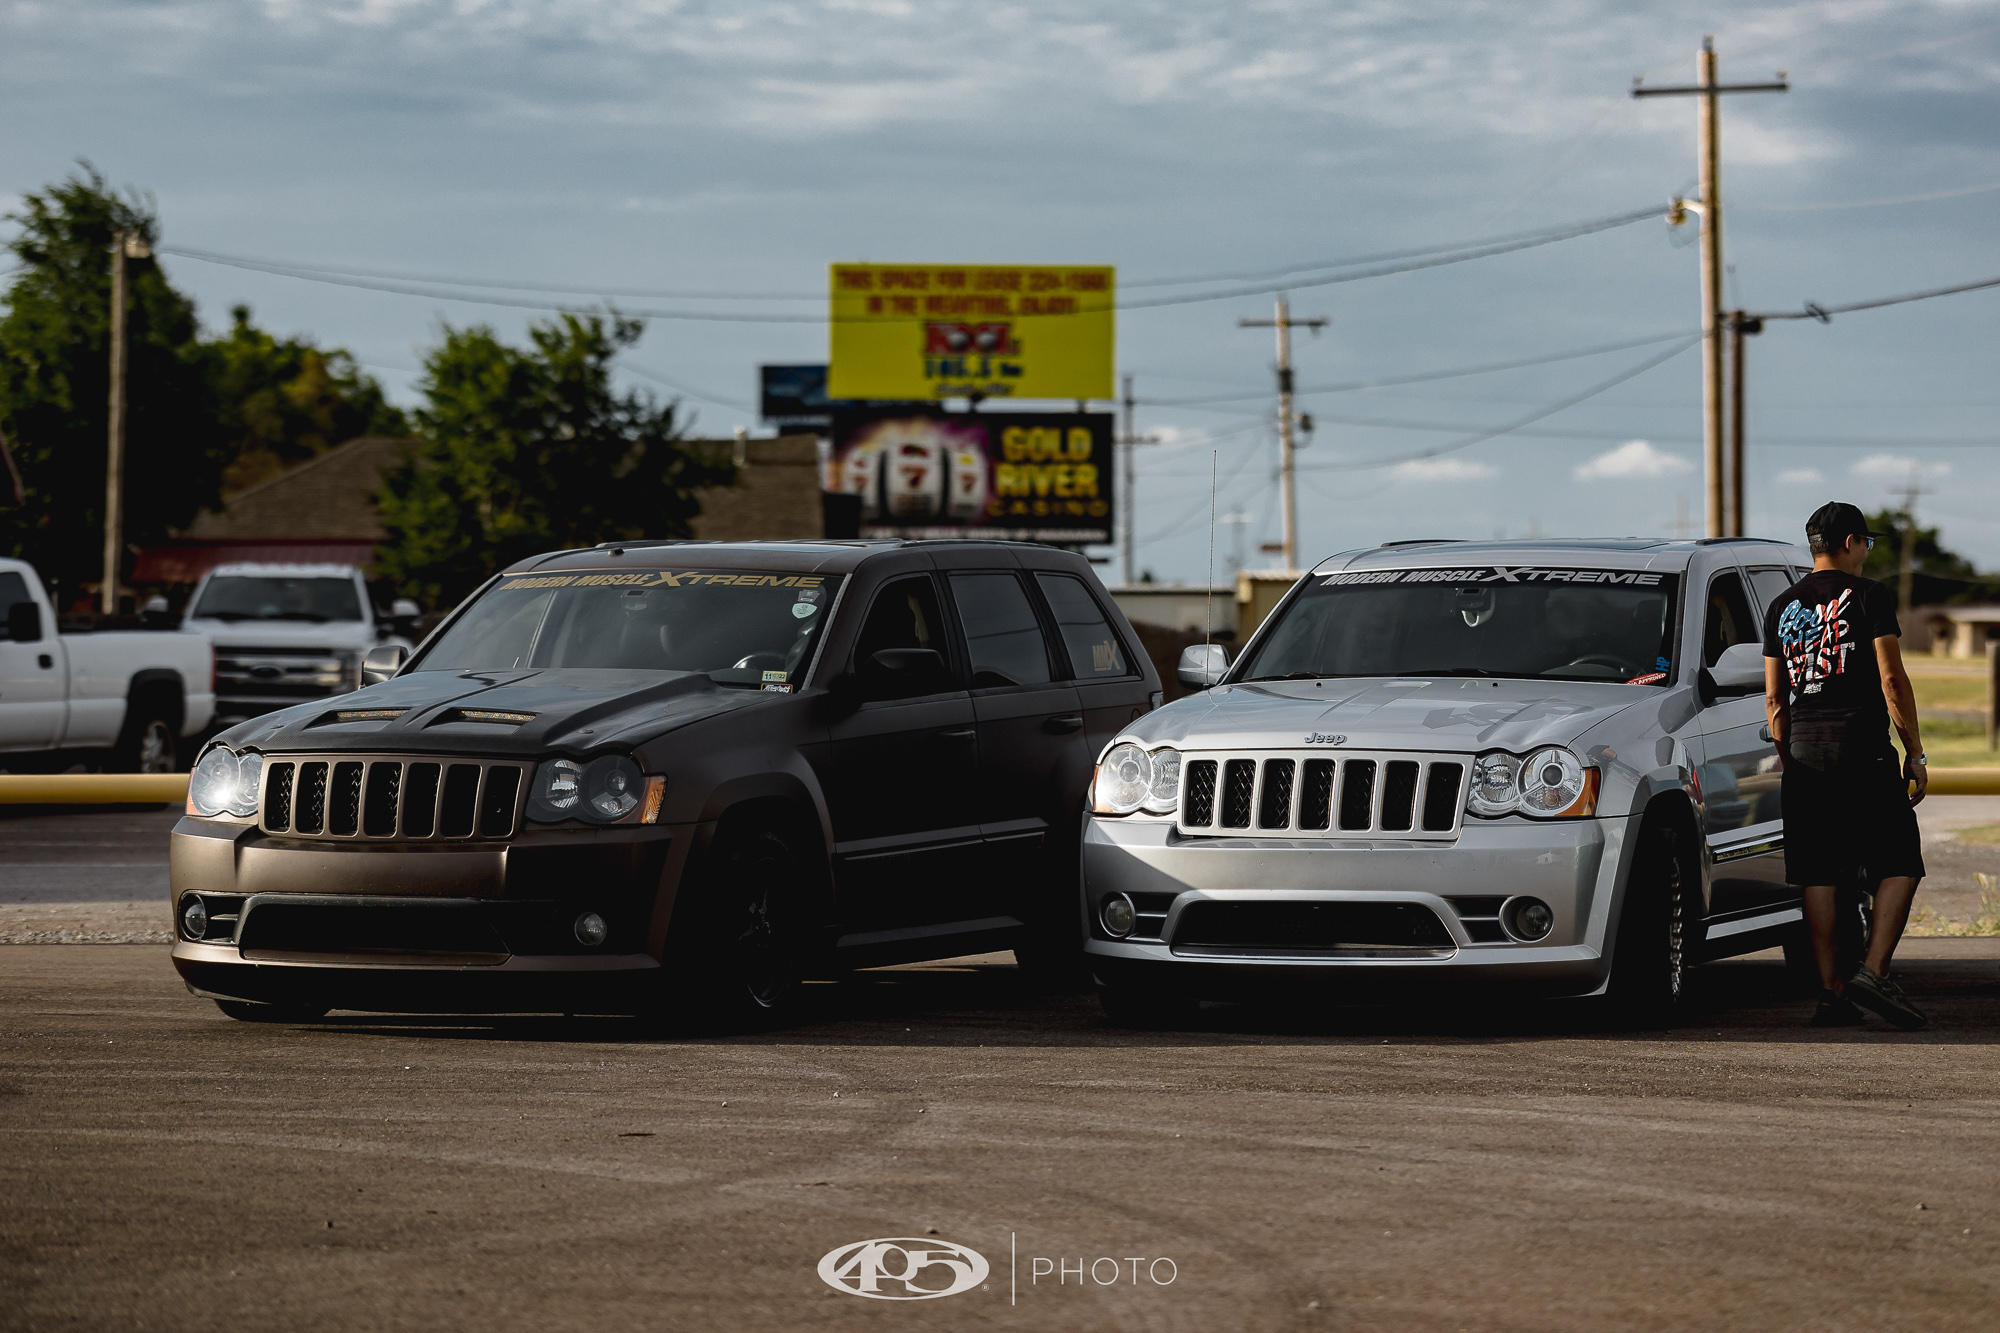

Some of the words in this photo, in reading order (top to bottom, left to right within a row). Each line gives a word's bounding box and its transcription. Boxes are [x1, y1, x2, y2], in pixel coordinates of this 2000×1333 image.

[1002, 426, 1094, 462] GOLD
[995, 463, 1099, 498] RIVER
[988, 500, 1109, 517] CASINO
[500, 576, 579, 590] MODERN
[572, 573, 655, 587] MUSCLE
[642, 571, 825, 588] XTREME
[1320, 571, 1405, 586] MODERN
[1400, 570, 1486, 583] MUSCLE
[1478, 567, 1663, 585] XTREME
[1304, 732, 1347, 746] Jeep
